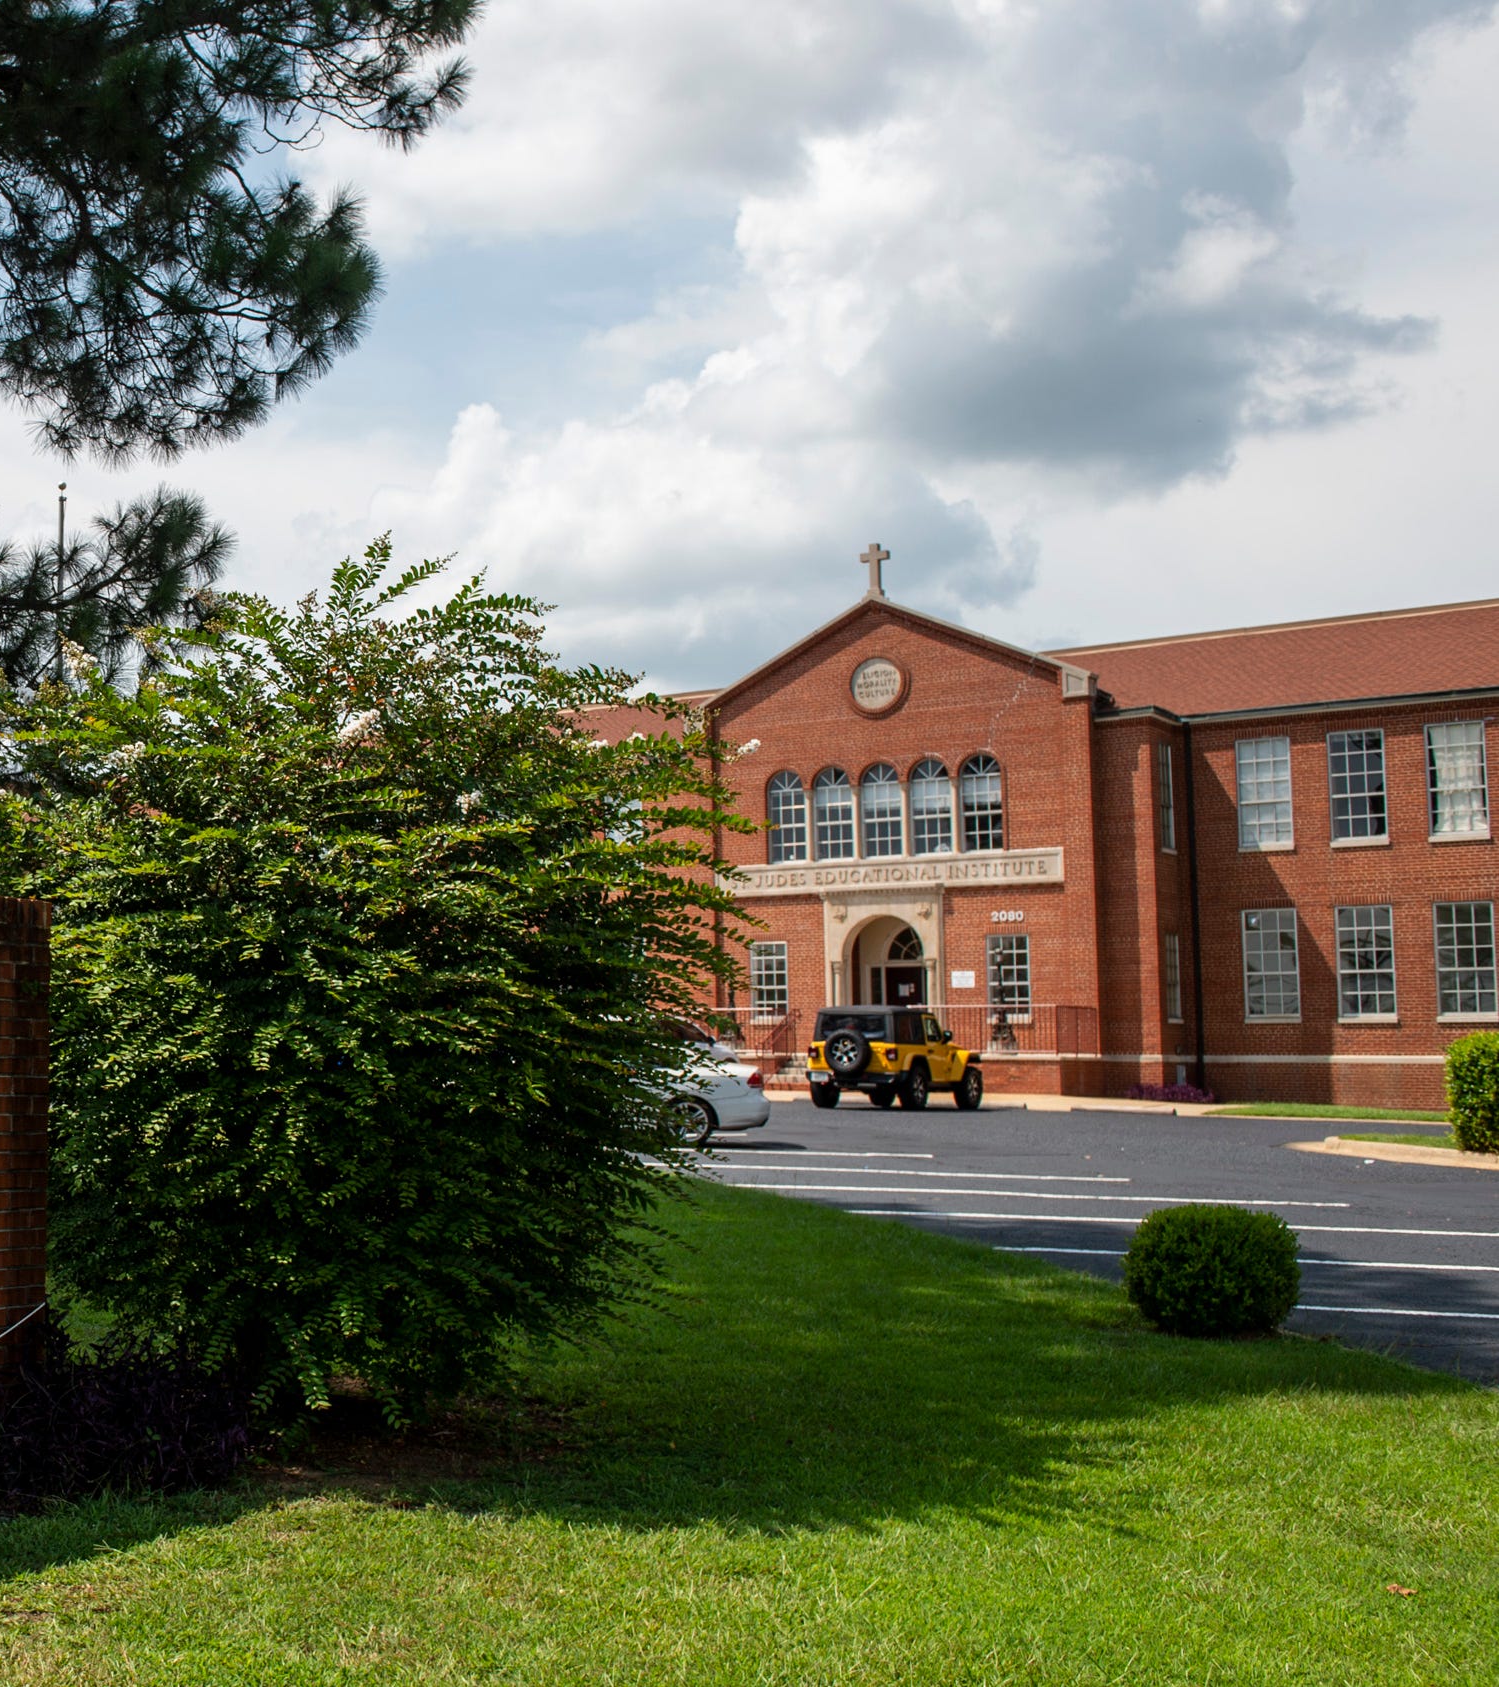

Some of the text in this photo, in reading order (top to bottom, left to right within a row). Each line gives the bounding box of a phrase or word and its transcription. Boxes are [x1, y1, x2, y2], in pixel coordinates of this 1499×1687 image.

[755, 873, 805, 889] JUDES
[815, 866, 941, 886] EDUCATIONAL
[947, 860, 1048, 880] INSTITUTE
[990, 910, 1025, 923] 2080
